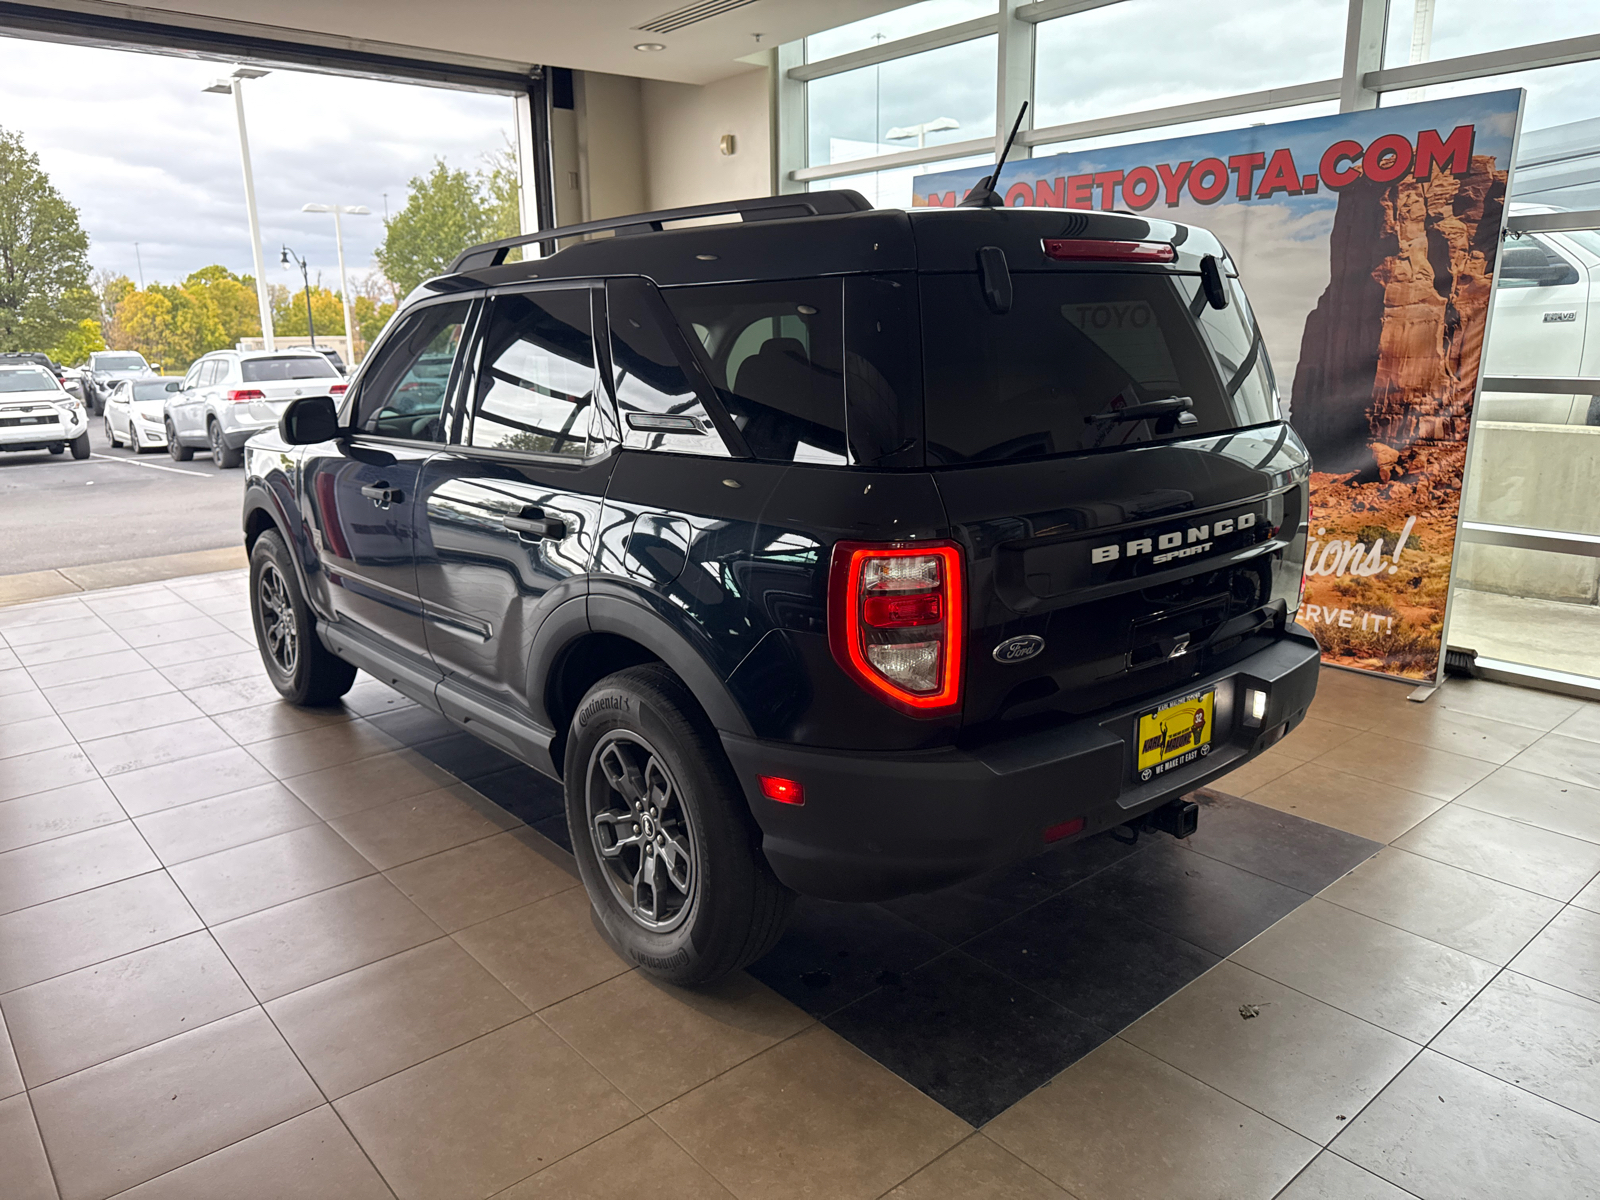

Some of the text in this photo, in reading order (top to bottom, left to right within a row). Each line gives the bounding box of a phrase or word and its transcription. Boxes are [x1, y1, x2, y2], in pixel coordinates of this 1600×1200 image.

[1091, 512, 1256, 565] BRONCO
[1305, 515, 1417, 577] ions!
[1152, 541, 1214, 565] SPORT
[1361, 612, 1393, 635] IT!
[578, 695, 623, 728] Continental
[1195, 713, 1203, 723] 32
[1155, 750, 1198, 774] WE MAKE IT EASY
